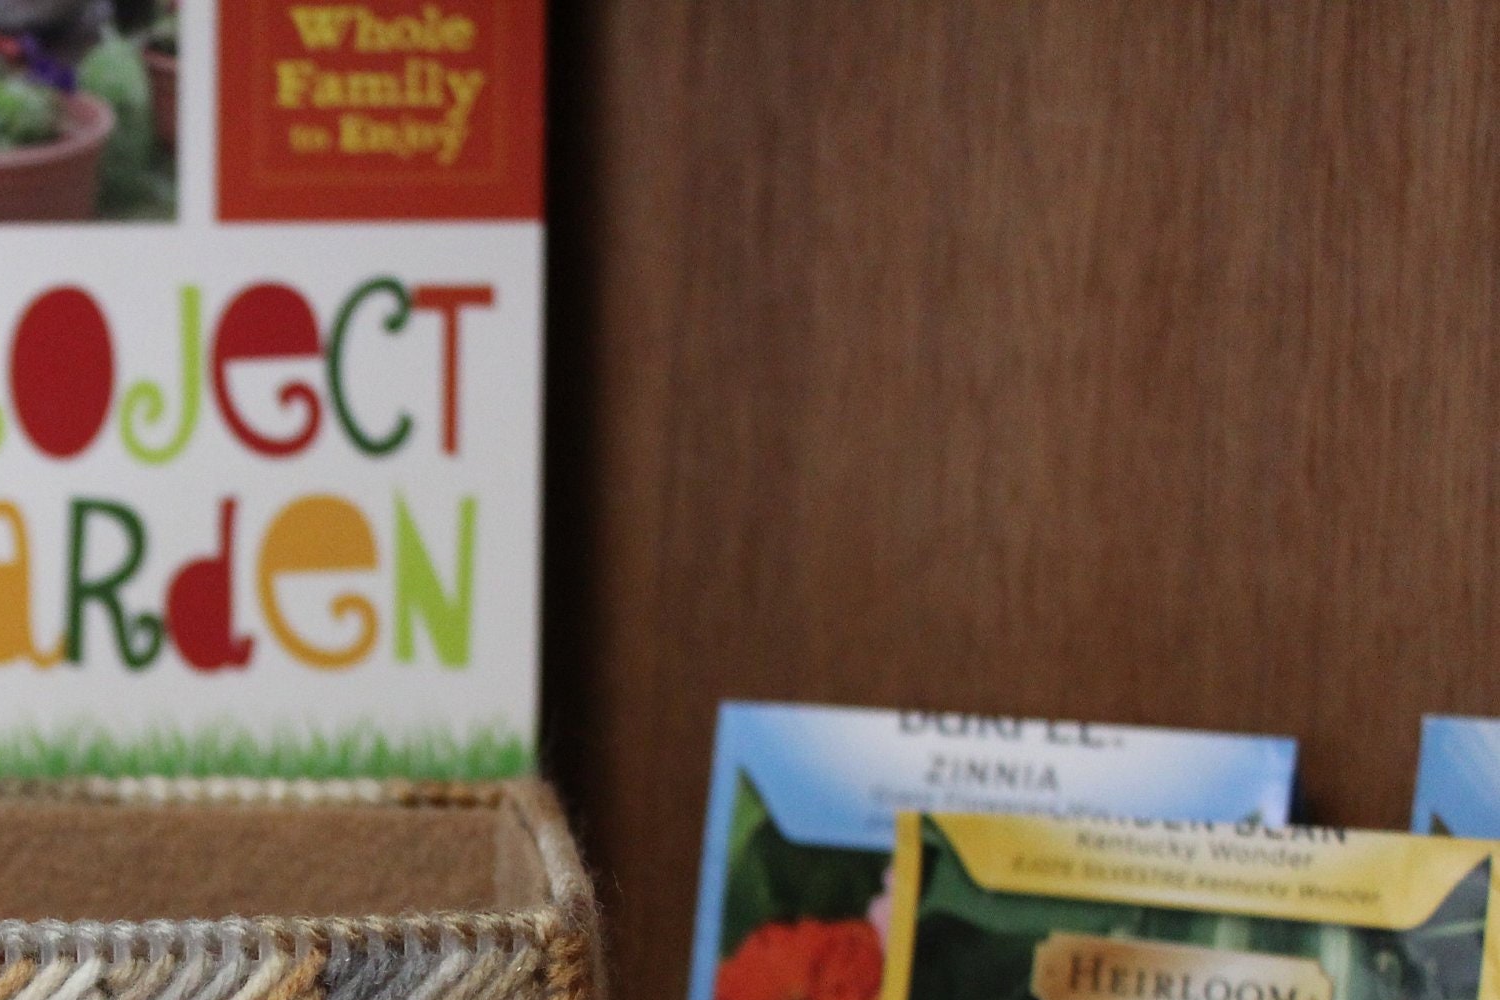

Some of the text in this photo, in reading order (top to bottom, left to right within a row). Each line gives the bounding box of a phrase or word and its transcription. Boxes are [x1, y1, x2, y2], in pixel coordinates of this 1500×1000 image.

[290, 3, 475, 52] Whole
[275, 60, 486, 117] Family
[925, 753, 1059, 791] ZINNIA
[1075, 830, 1315, 870] Kentucky Wonder
